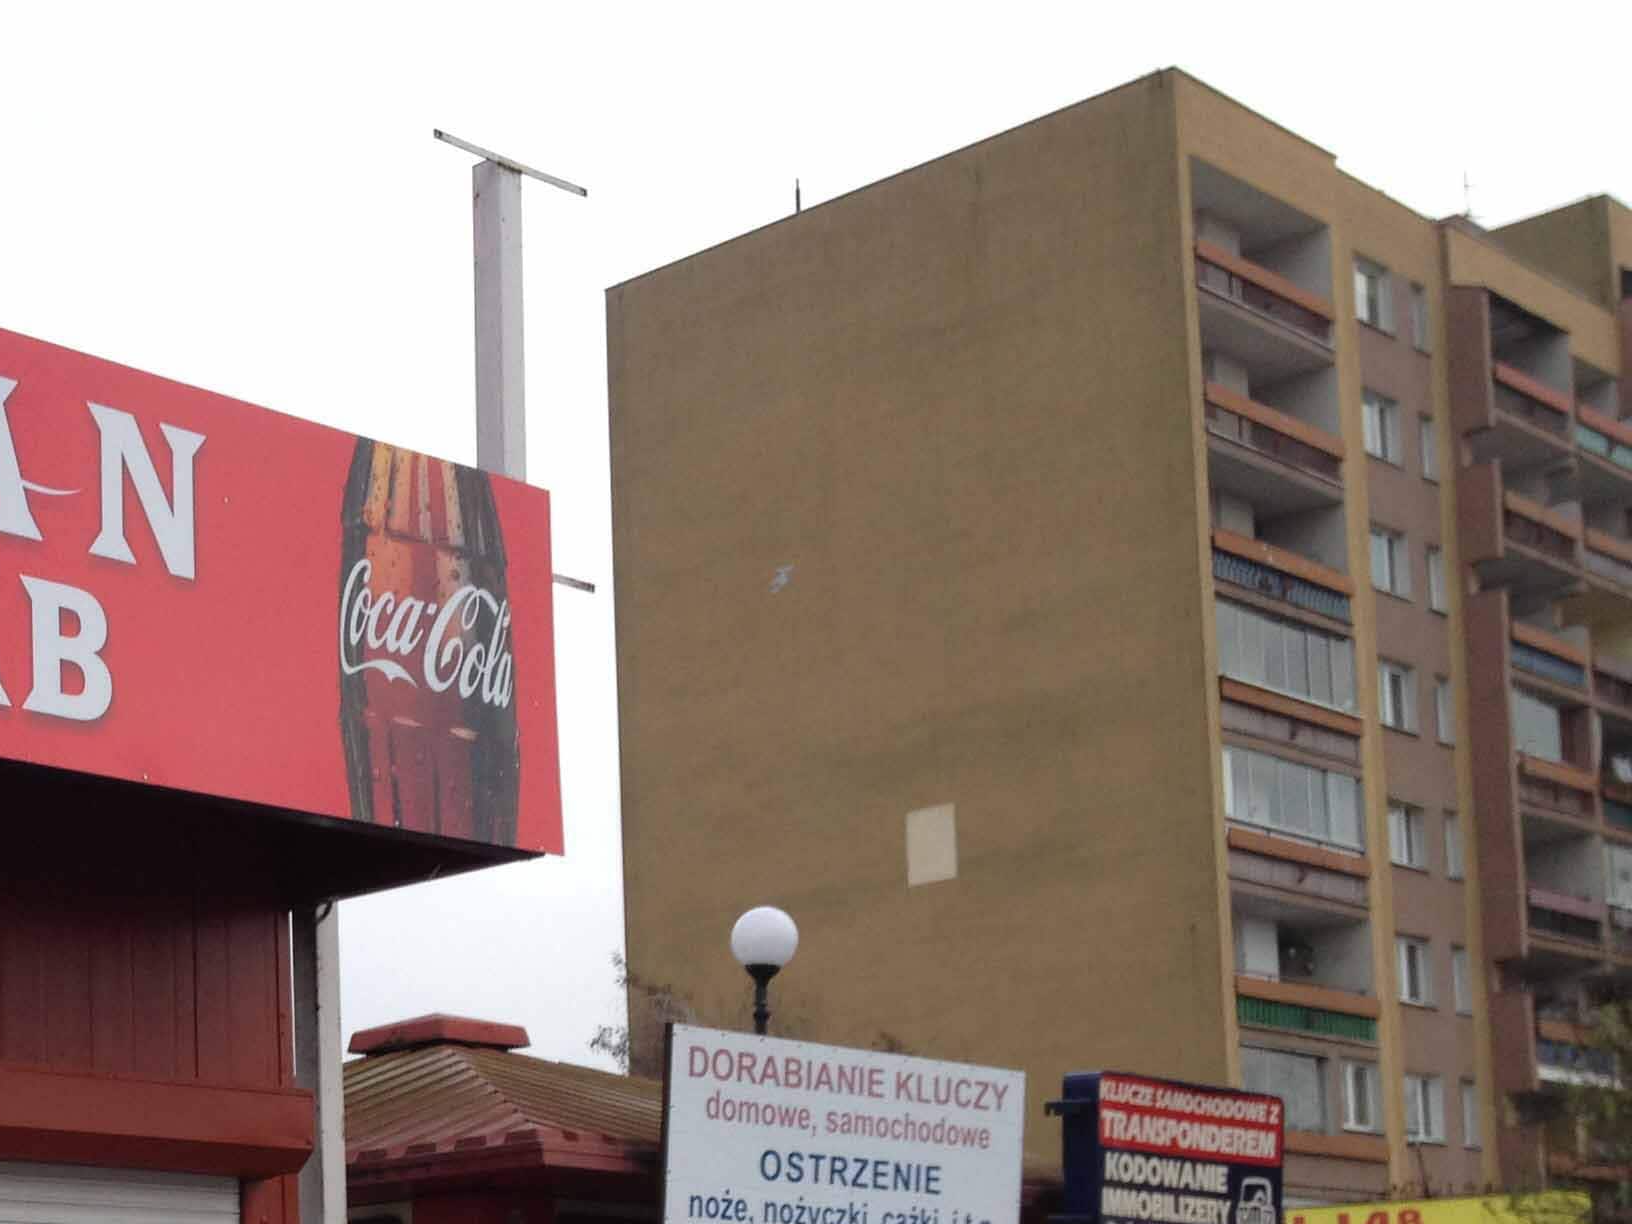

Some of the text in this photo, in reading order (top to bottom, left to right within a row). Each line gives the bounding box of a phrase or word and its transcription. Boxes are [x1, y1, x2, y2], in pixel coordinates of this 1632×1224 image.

[340, 558, 513, 709] Coca-Cola
[688, 1045, 1010, 1112] DORABIANIE KLUCZY
[1100, 1078, 1280, 1125] KLUCZE SAMOCHODOWE Z
[706, 1090, 990, 1149] domowe, samochodowe
[1102, 1109, 1277, 1158] TRANSPONDEREM
[759, 1149, 942, 1196] OSTRZENIE
[1104, 1151, 1230, 1193] KODOWANIE
